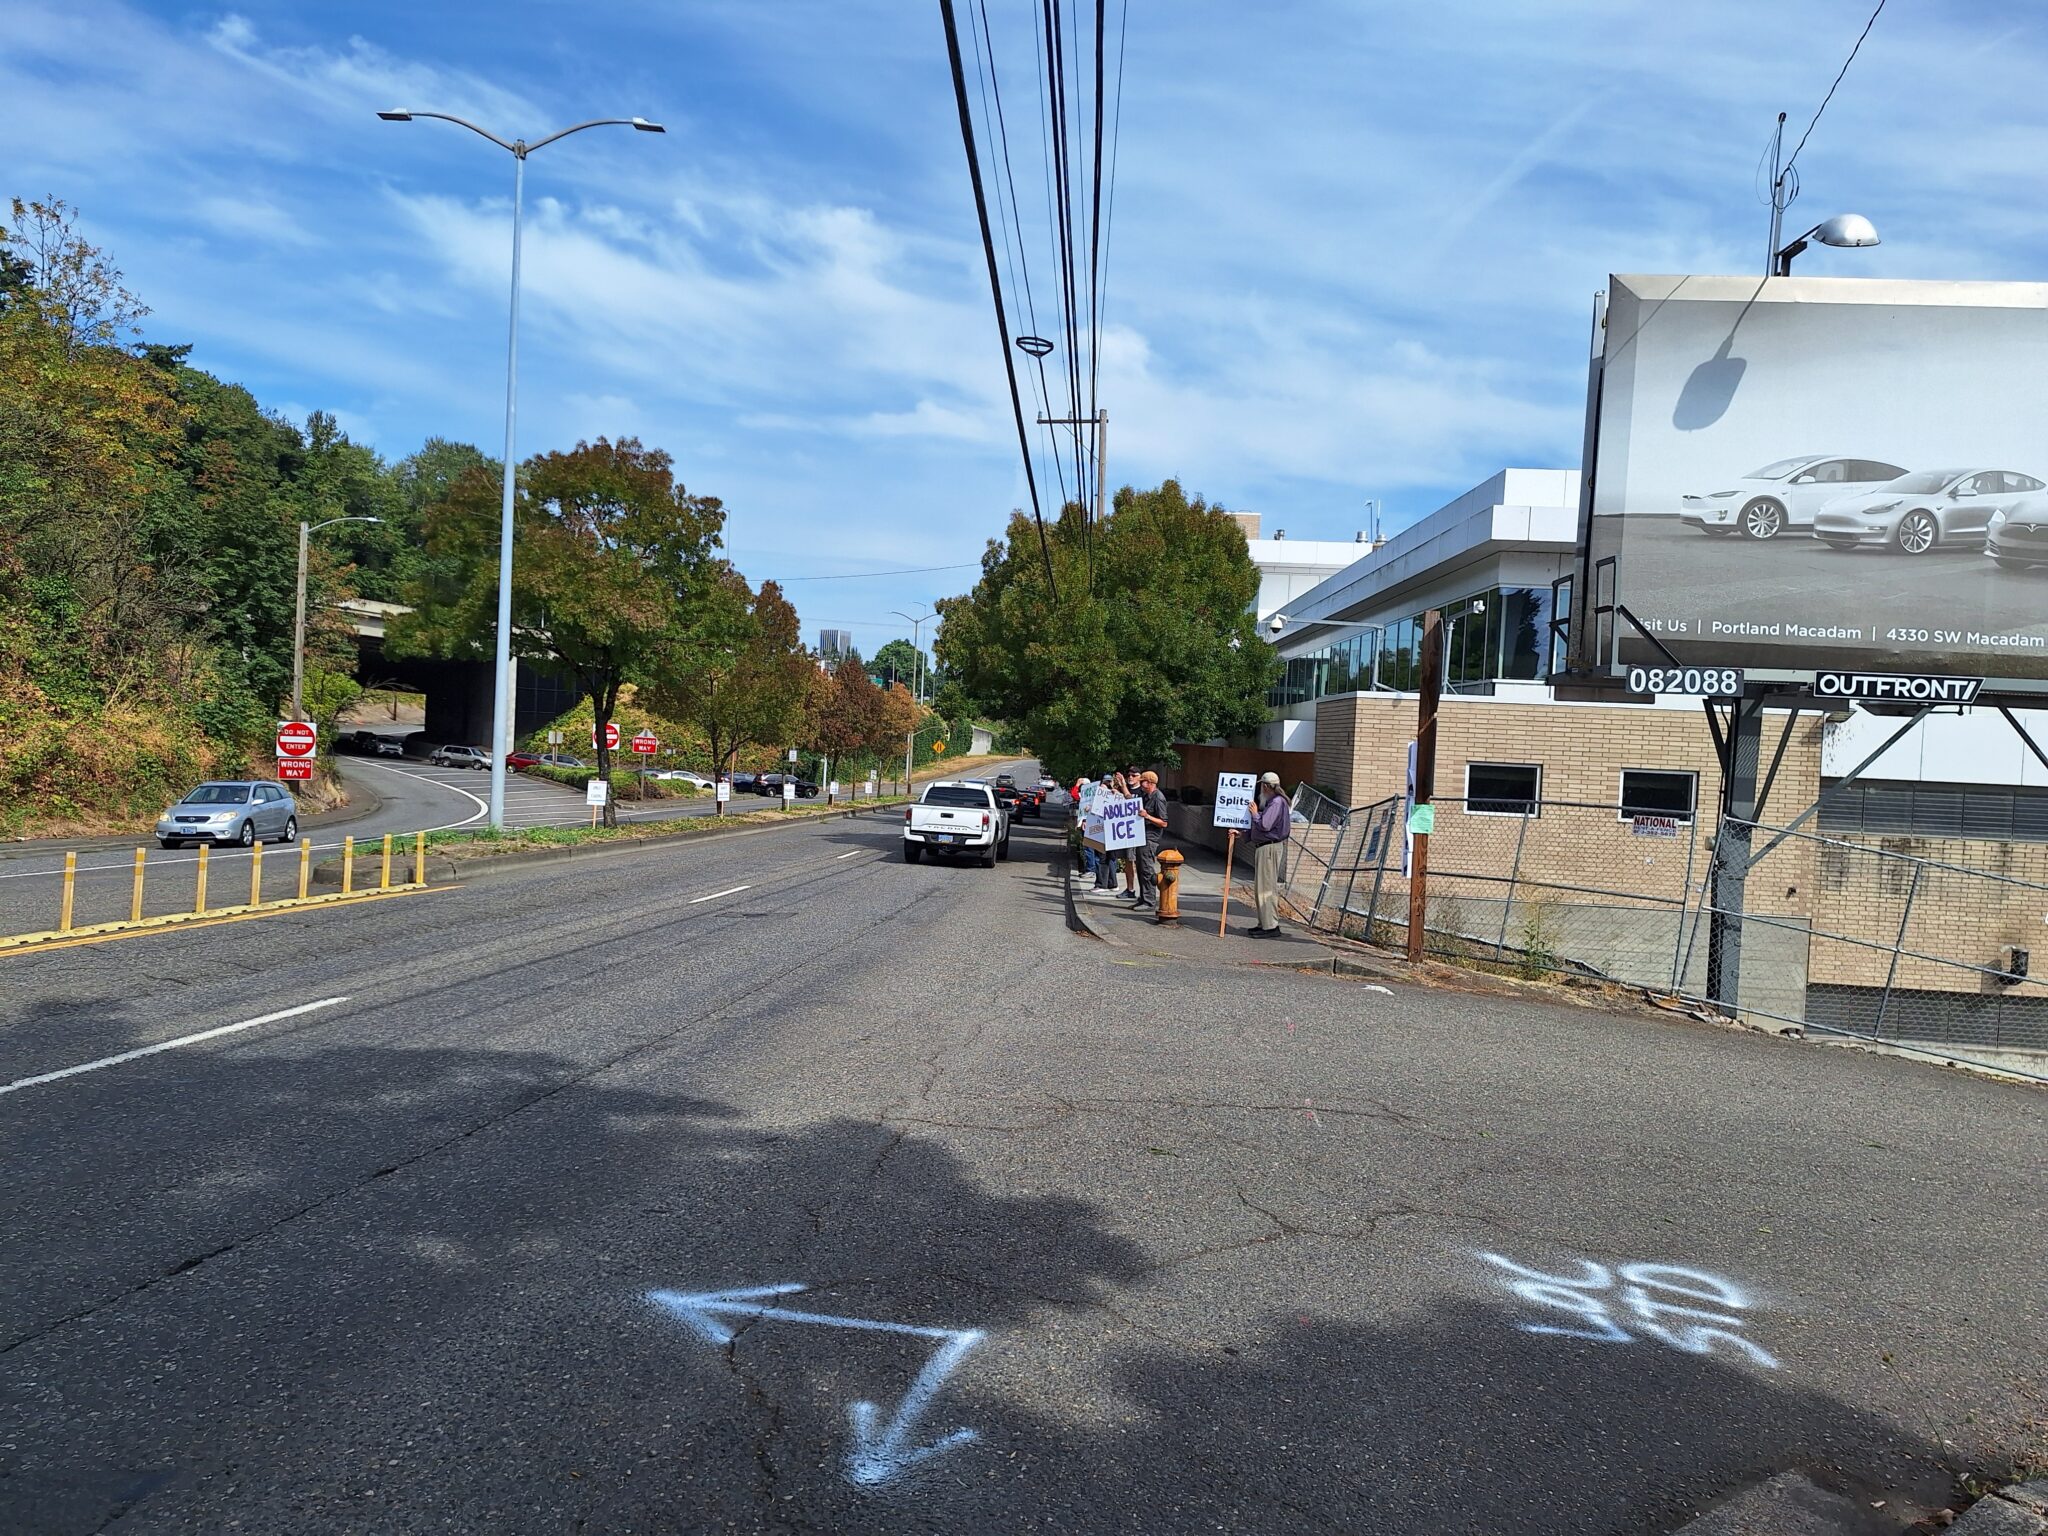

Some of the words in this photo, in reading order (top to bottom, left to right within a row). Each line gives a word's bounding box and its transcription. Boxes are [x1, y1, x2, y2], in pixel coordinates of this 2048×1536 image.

[1668, 619, 1688, 632] Us
[1712, 621, 1780, 636] Portland
[1785, 623, 1862, 639] Macadam
[1886, 628, 1929, 642] 4330
[1933, 630, 1962, 643] SW
[1967, 632, 2045, 647] Macadam
[1629, 668, 1738, 695] 082088
[281, 761, 311, 769] WRONG
[1220, 776, 1253, 789] I.C.E.
[1219, 795, 1250, 807] Splits
[1103, 801, 1140, 820] ABOLISH
[1216, 815, 1249, 825] Families
[1634, 816, 1677, 829] NATIONAL
[1112, 820, 1136, 840] ICE
